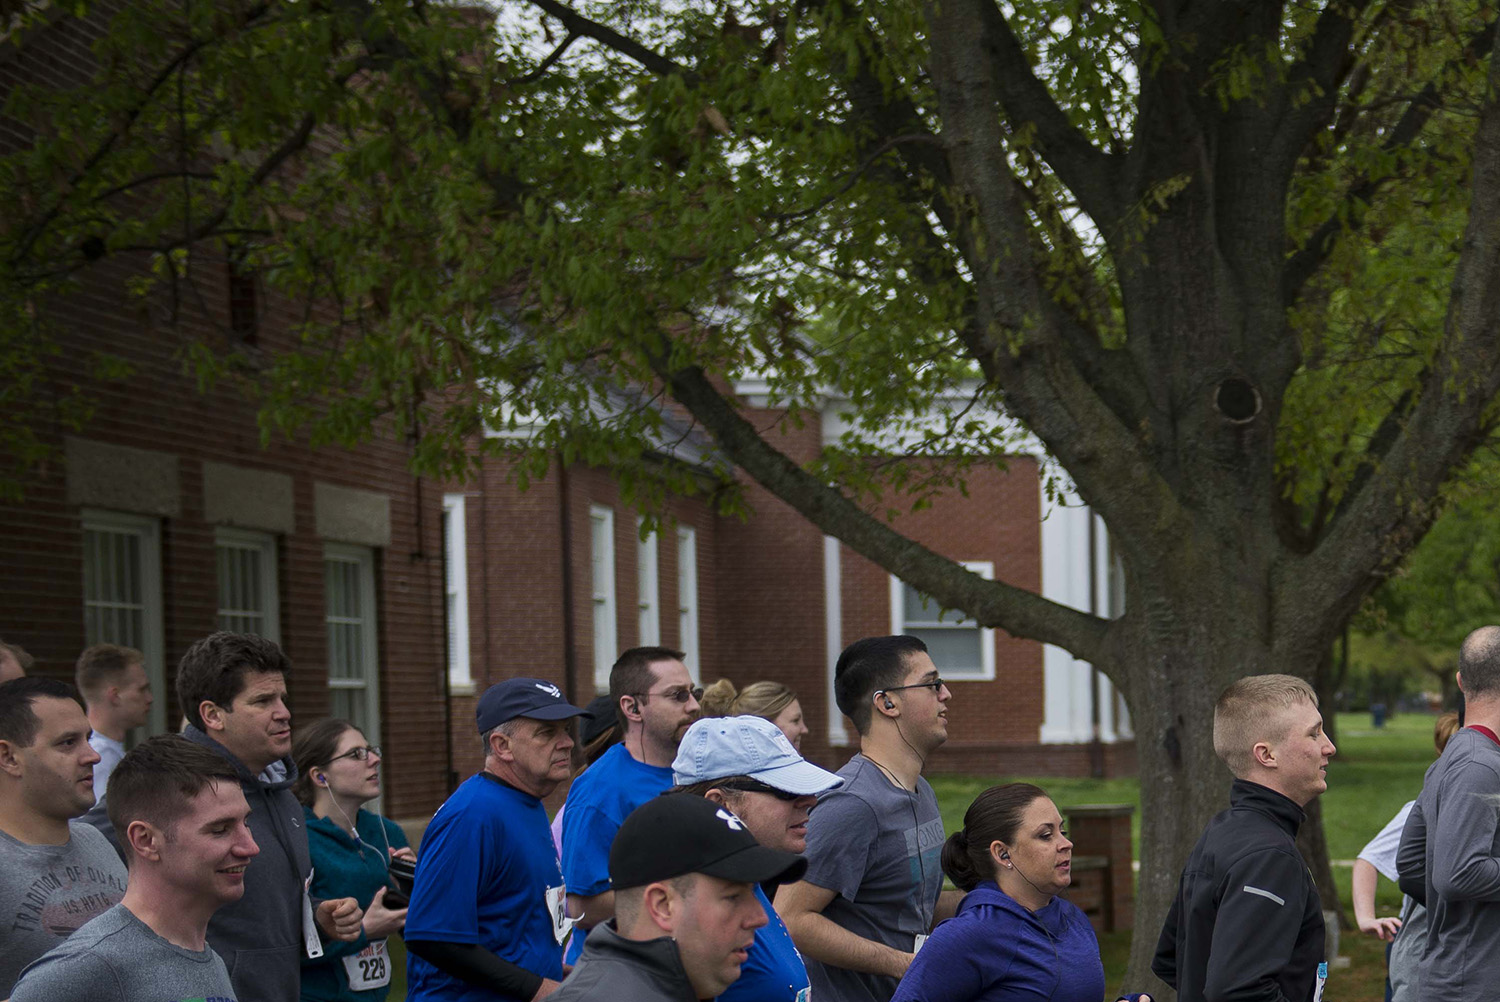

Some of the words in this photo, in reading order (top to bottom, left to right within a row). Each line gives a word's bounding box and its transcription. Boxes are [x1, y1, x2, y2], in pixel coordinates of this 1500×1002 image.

[12, 870, 62, 932] TRADITION
[65, 865, 81, 883] OF
[359, 957, 386, 982] 229
